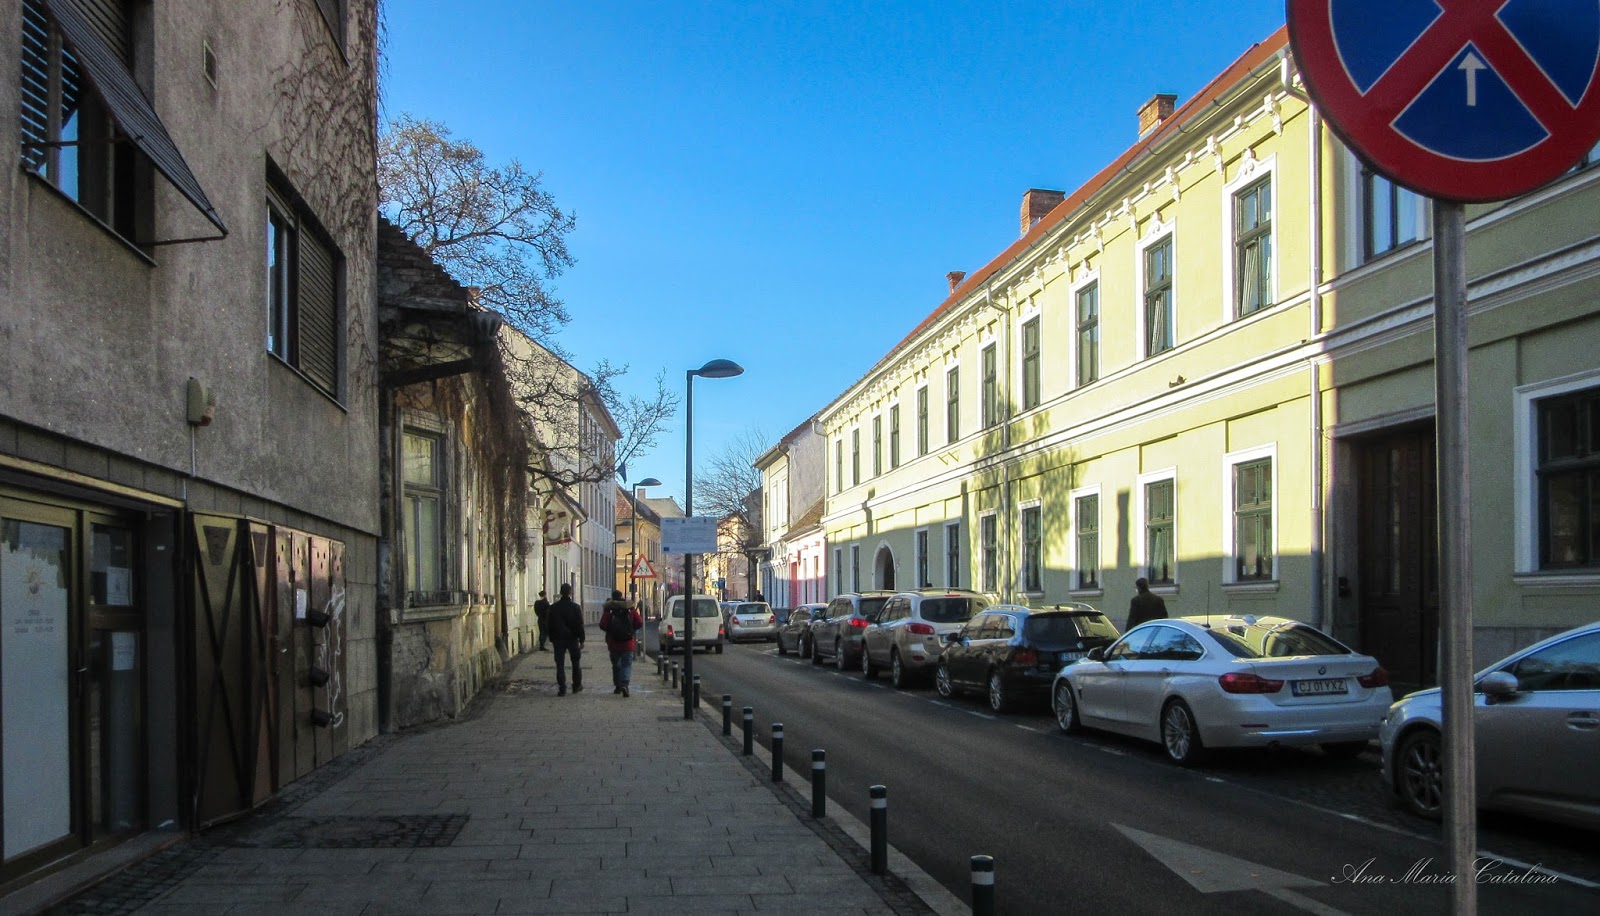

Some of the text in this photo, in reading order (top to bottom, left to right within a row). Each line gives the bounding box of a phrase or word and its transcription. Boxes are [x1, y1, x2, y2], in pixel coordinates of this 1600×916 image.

[1299, 680, 1345, 692] CJ 01 YXZ
